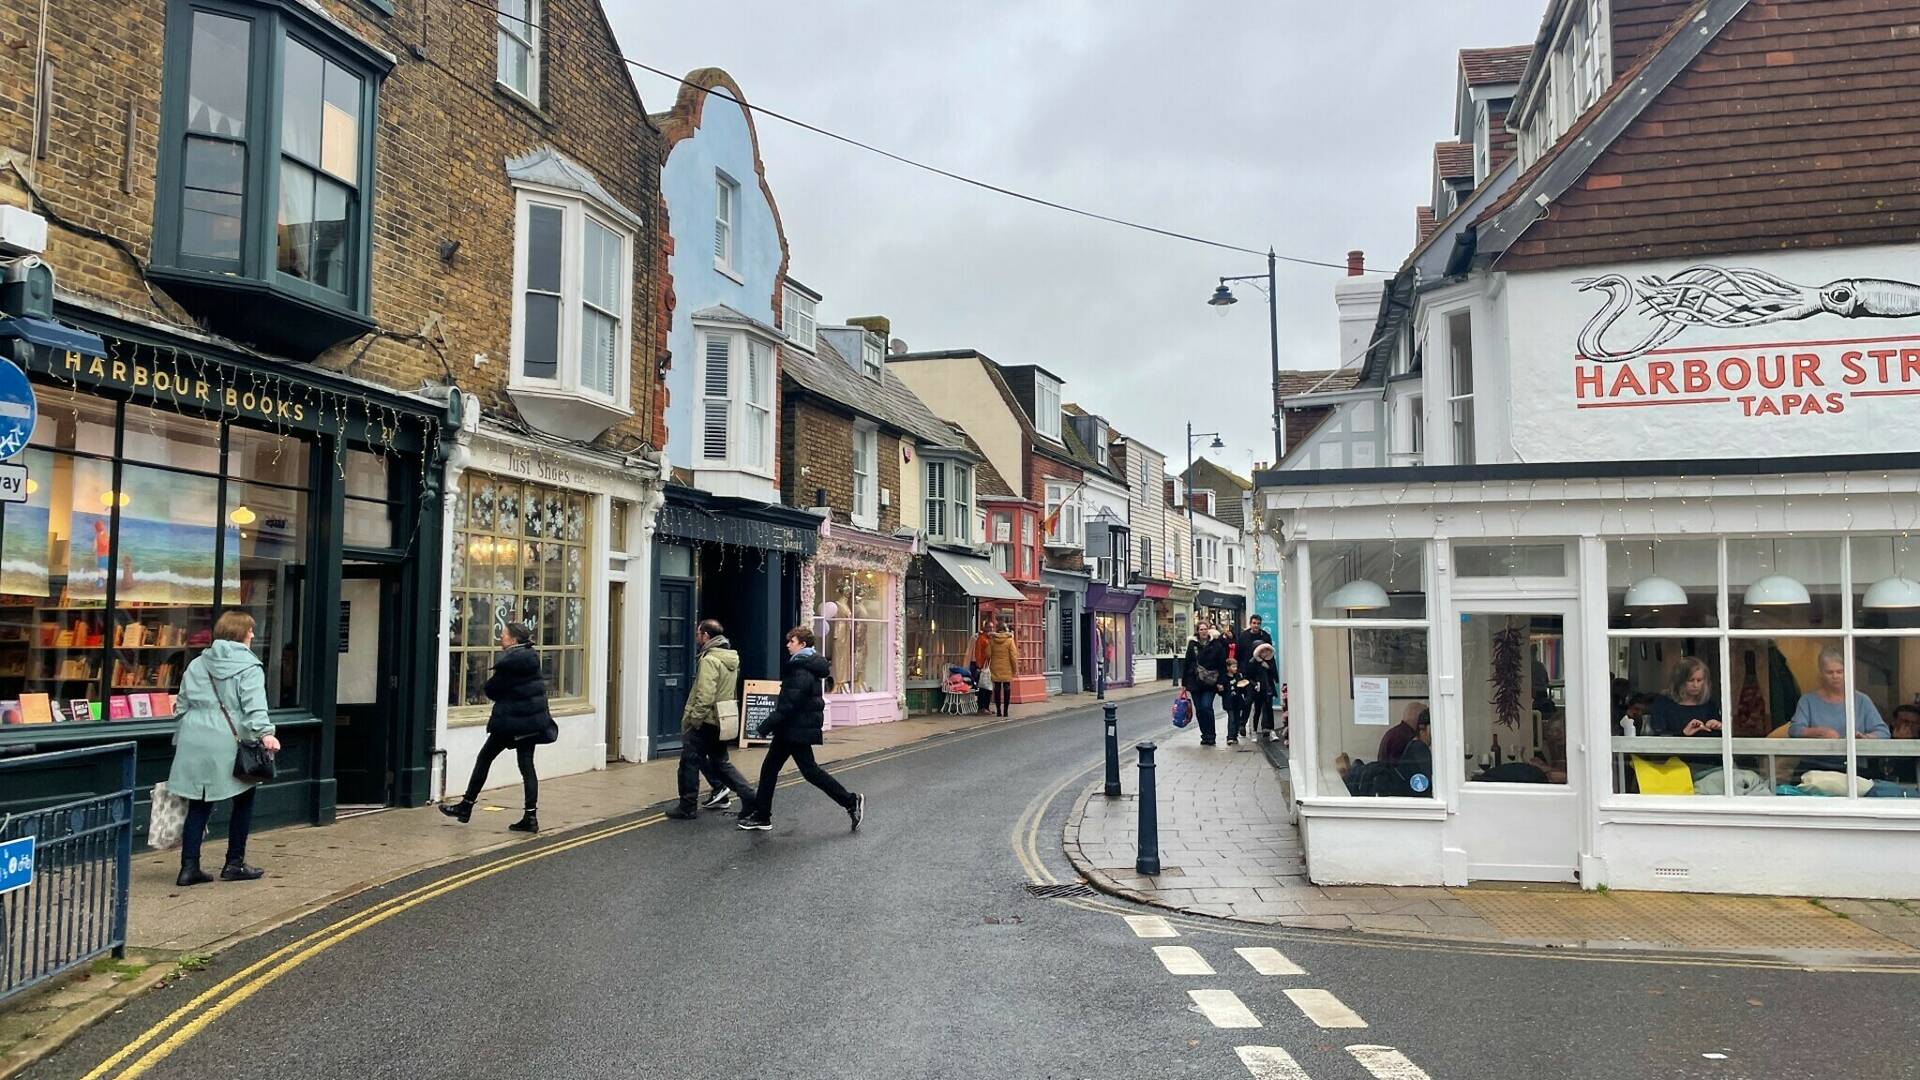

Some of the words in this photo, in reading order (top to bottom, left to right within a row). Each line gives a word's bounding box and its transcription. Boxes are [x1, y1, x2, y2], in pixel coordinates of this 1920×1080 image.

[65, 350, 210, 402] HARBOUR
[226, 388, 304, 421] BOOKS
[1575, 353, 1825, 399] HARBOUR
[1737, 393, 1845, 417] TAPAS
[508, 453, 530, 476] Just
[537, 460, 570, 484] Shoes
[0, 477, 20, 493] ay
